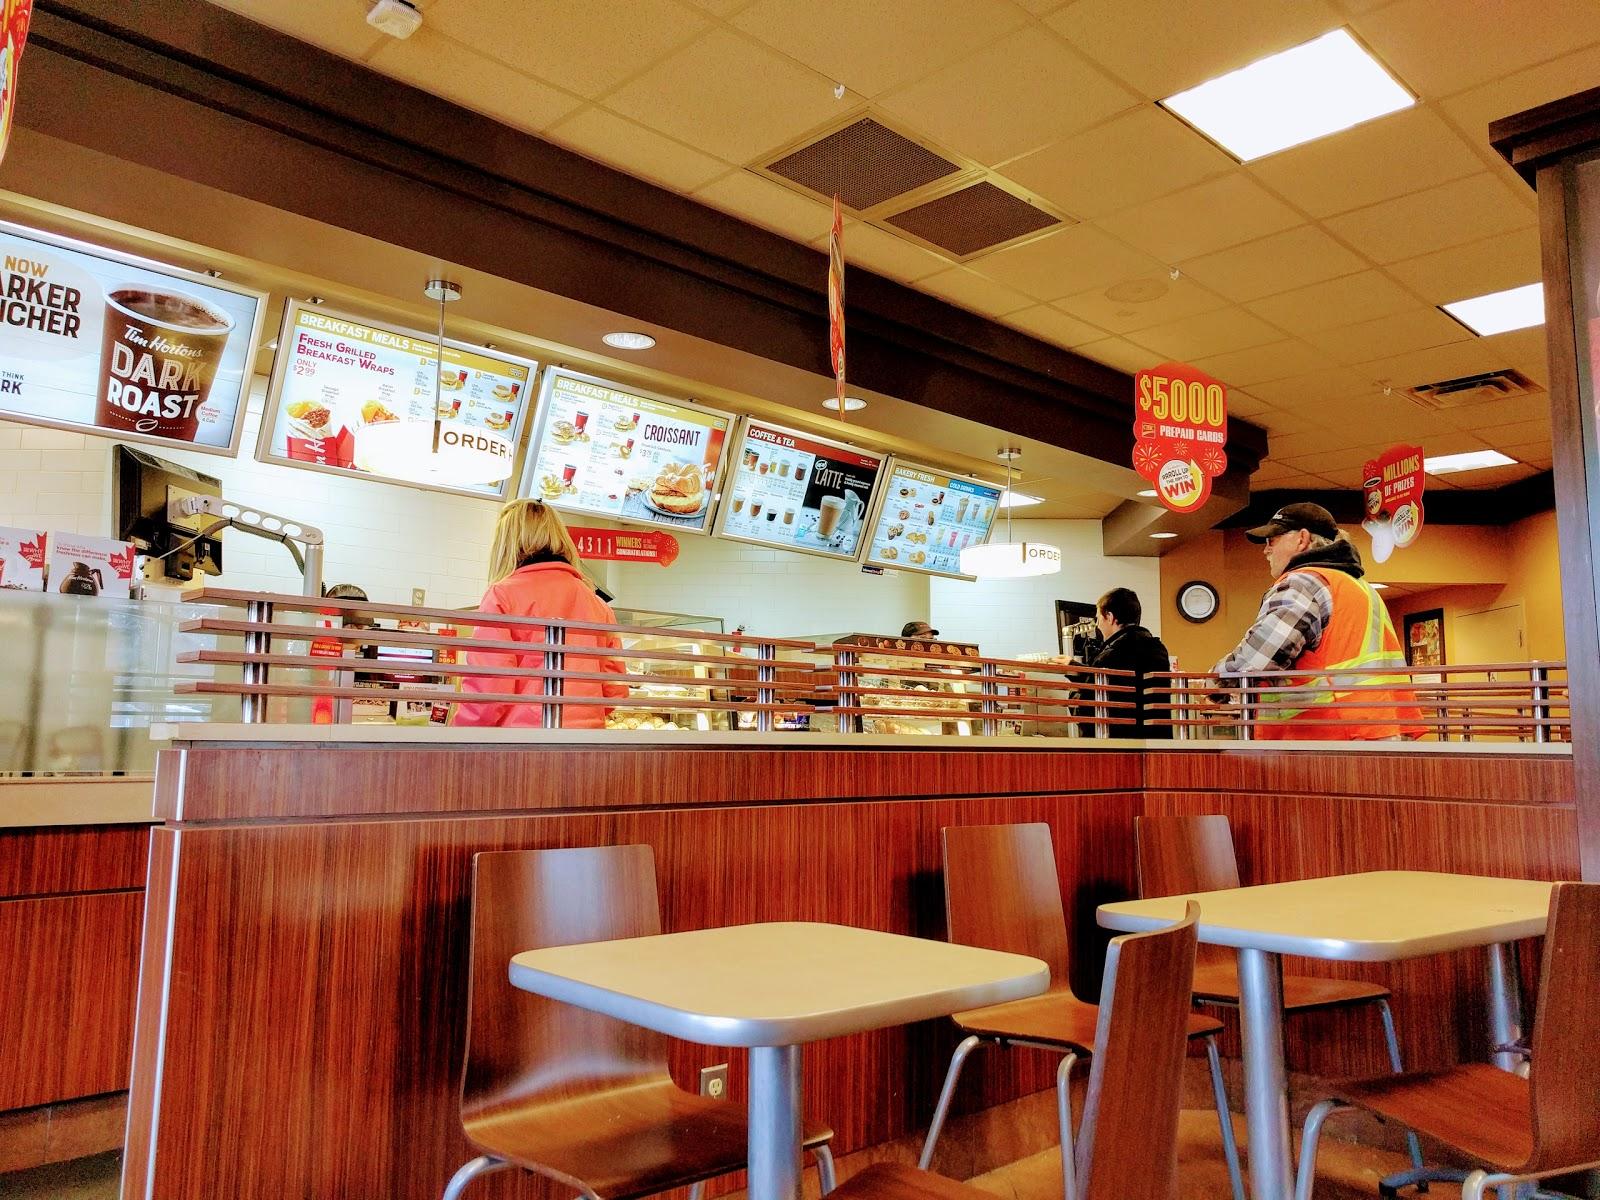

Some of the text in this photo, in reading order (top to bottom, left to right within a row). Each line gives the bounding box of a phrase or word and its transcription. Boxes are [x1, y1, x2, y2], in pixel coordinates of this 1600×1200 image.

[5, 255, 48, 277] NOW
[124, 324, 203, 359] Tim Hortons
[300, 313, 410, 350] BREAKFAST MEALS
[111, 340, 207, 391] DARK
[297, 358, 317, 368] ONLY
[2, 370, 24, 380] THINK
[107, 376, 199, 419] ROAST
[556, 380, 610, 400] BREAKFAST
[610, 391, 640, 406] MEALS
[1140, 375, 1224, 427] $5000
[444, 431, 506, 459] ORDER
[644, 424, 701, 446] CROISSANT
[749, 428, 777, 443] COFFEE
[782, 437, 795, 448] TEA
[1160, 425, 1224, 443] PREPAID CARDS
[814, 468, 845, 490] LATTE
[895, 467, 936, 482] BAKERY FRESH
[1383, 454, 1420, 482] MILLIONS
[949, 482, 975, 493] COLD DRINKS
[1164, 479, 1196, 497] WIN
[1384, 484, 1392, 497] OF
[1393, 476, 1415, 494] PRIZES
[616, 536, 641, 548] WINNERS
